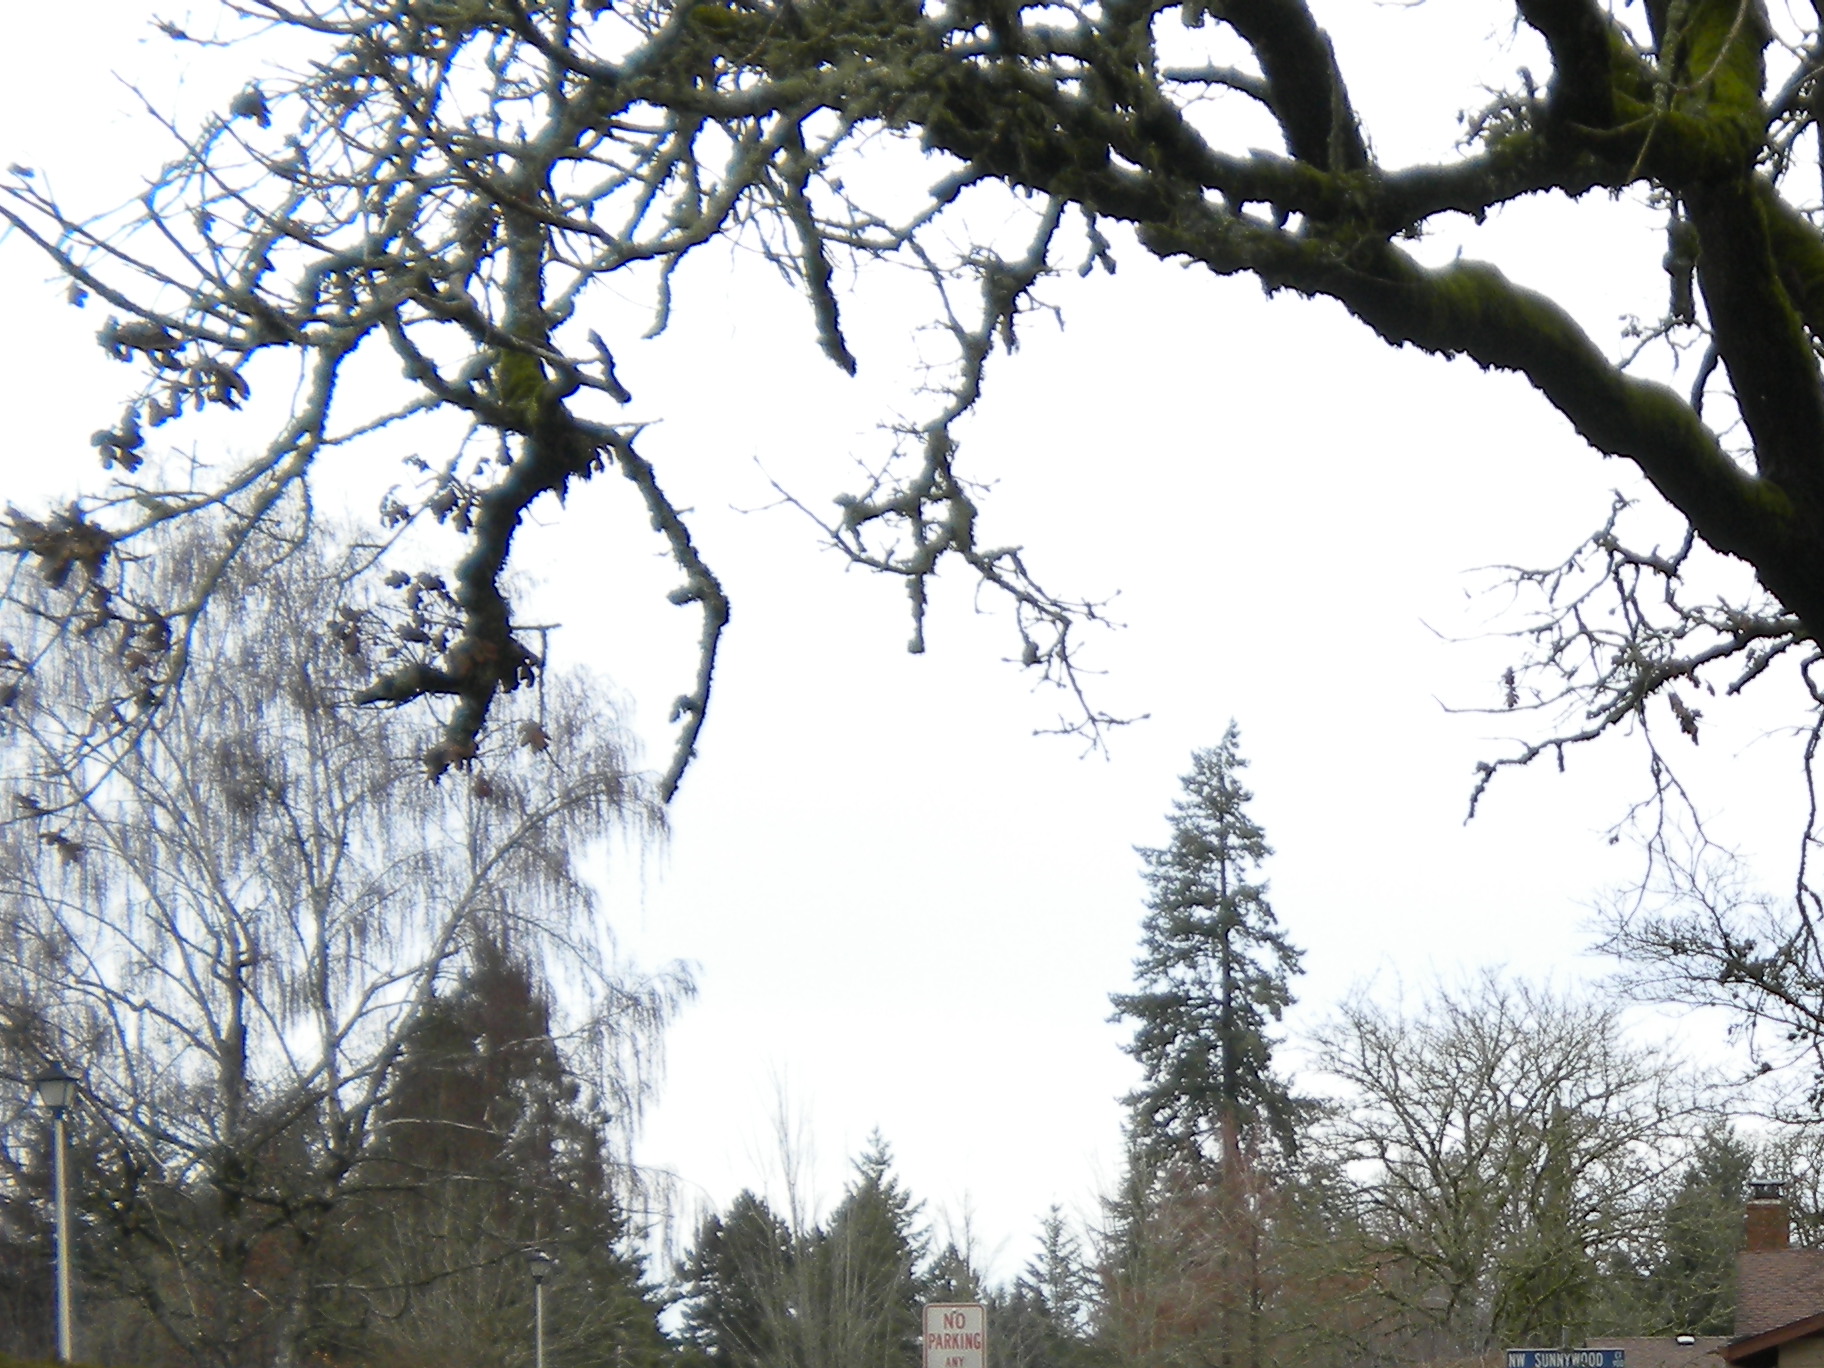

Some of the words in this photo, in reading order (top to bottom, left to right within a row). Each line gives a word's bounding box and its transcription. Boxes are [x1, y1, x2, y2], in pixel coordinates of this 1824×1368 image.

[944, 1312, 966, 1329] NO
[928, 1333, 981, 1349] PARKING
[945, 1356, 964, 1368] ANY
[1508, 1353, 1526, 1368] NW
[1534, 1352, 1604, 1368] SUNNYWOOD
